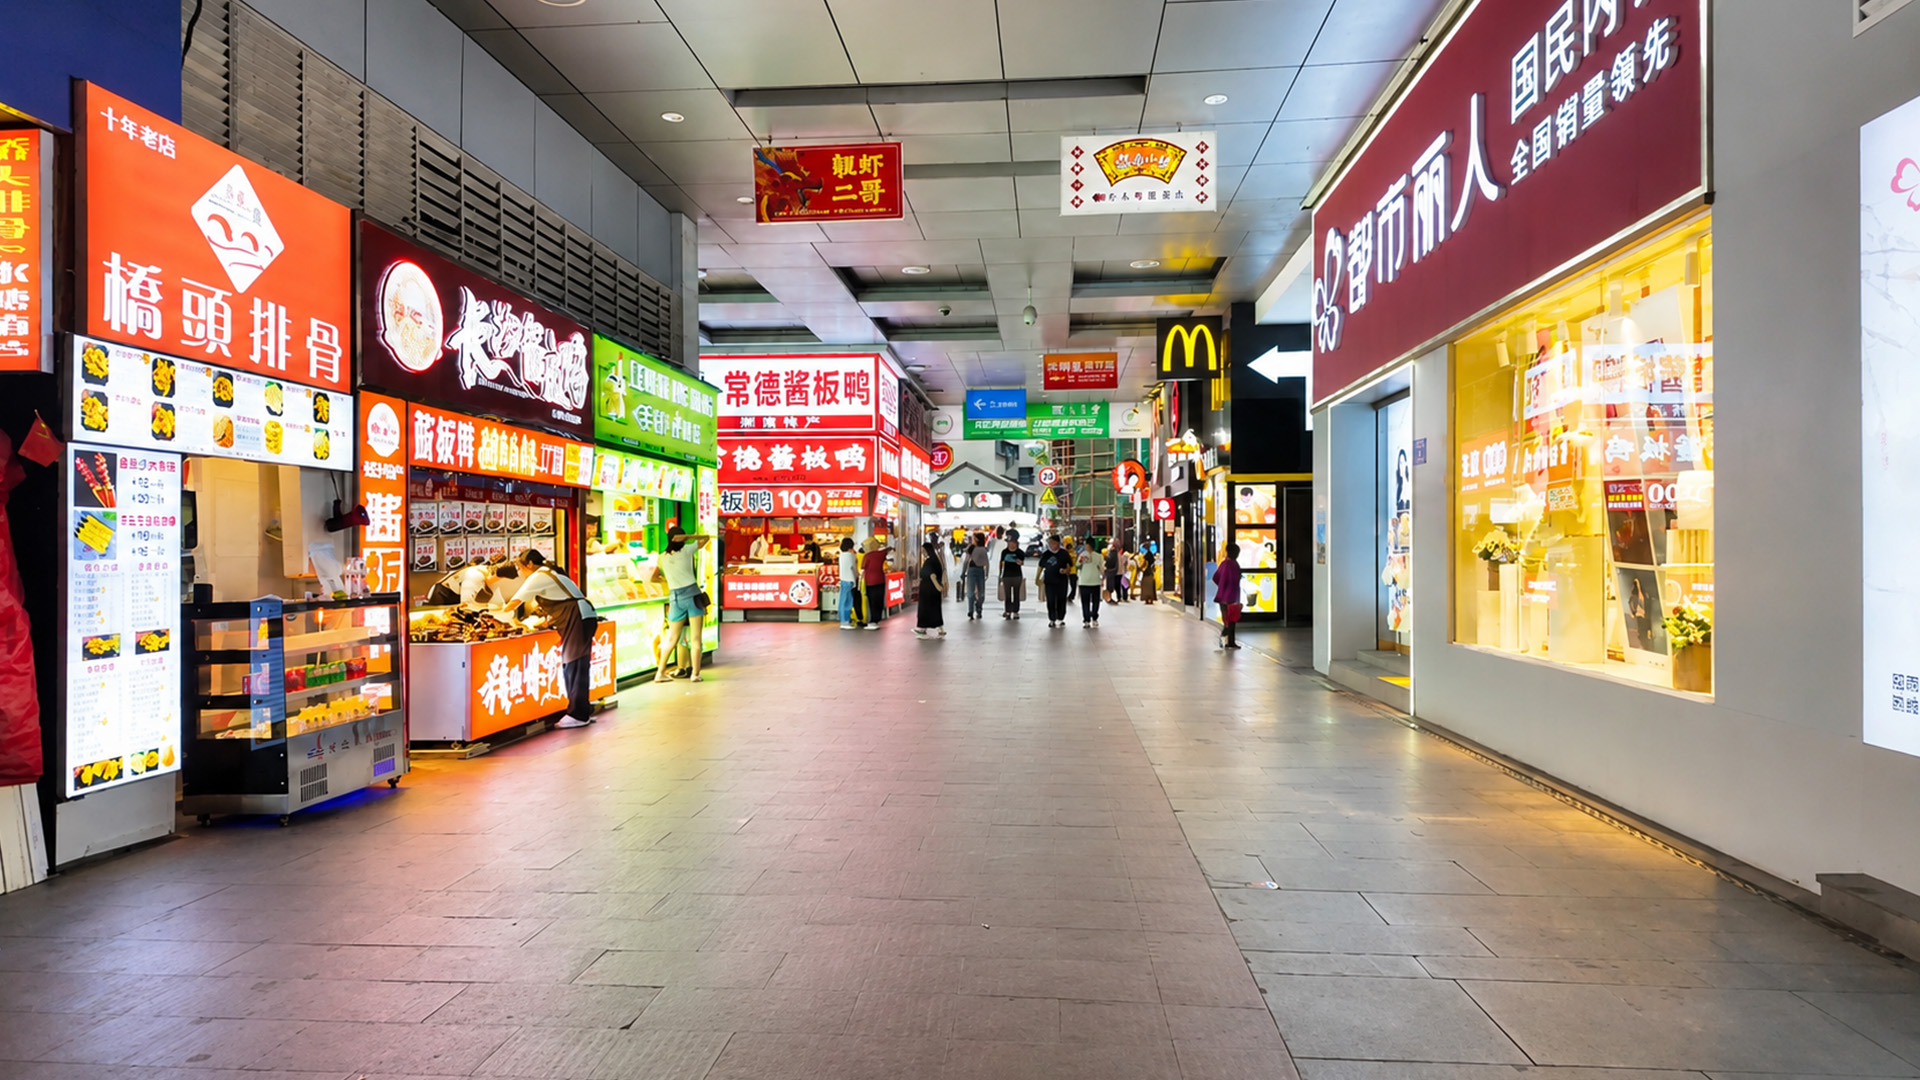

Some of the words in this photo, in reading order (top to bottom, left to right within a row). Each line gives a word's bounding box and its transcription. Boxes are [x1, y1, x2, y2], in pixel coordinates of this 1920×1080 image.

[1509, 0, 1657, 125] 国民内
[1509, 17, 1677, 186] 全国销量领先
[100, 106, 176, 160] 十年老店
[832, 179, 886, 205] 二哥
[1346, 92, 1504, 314] 都市丽人
[102, 251, 342, 384] 橋頭排骨
[724, 369, 870, 408] 常德酱板鸭
